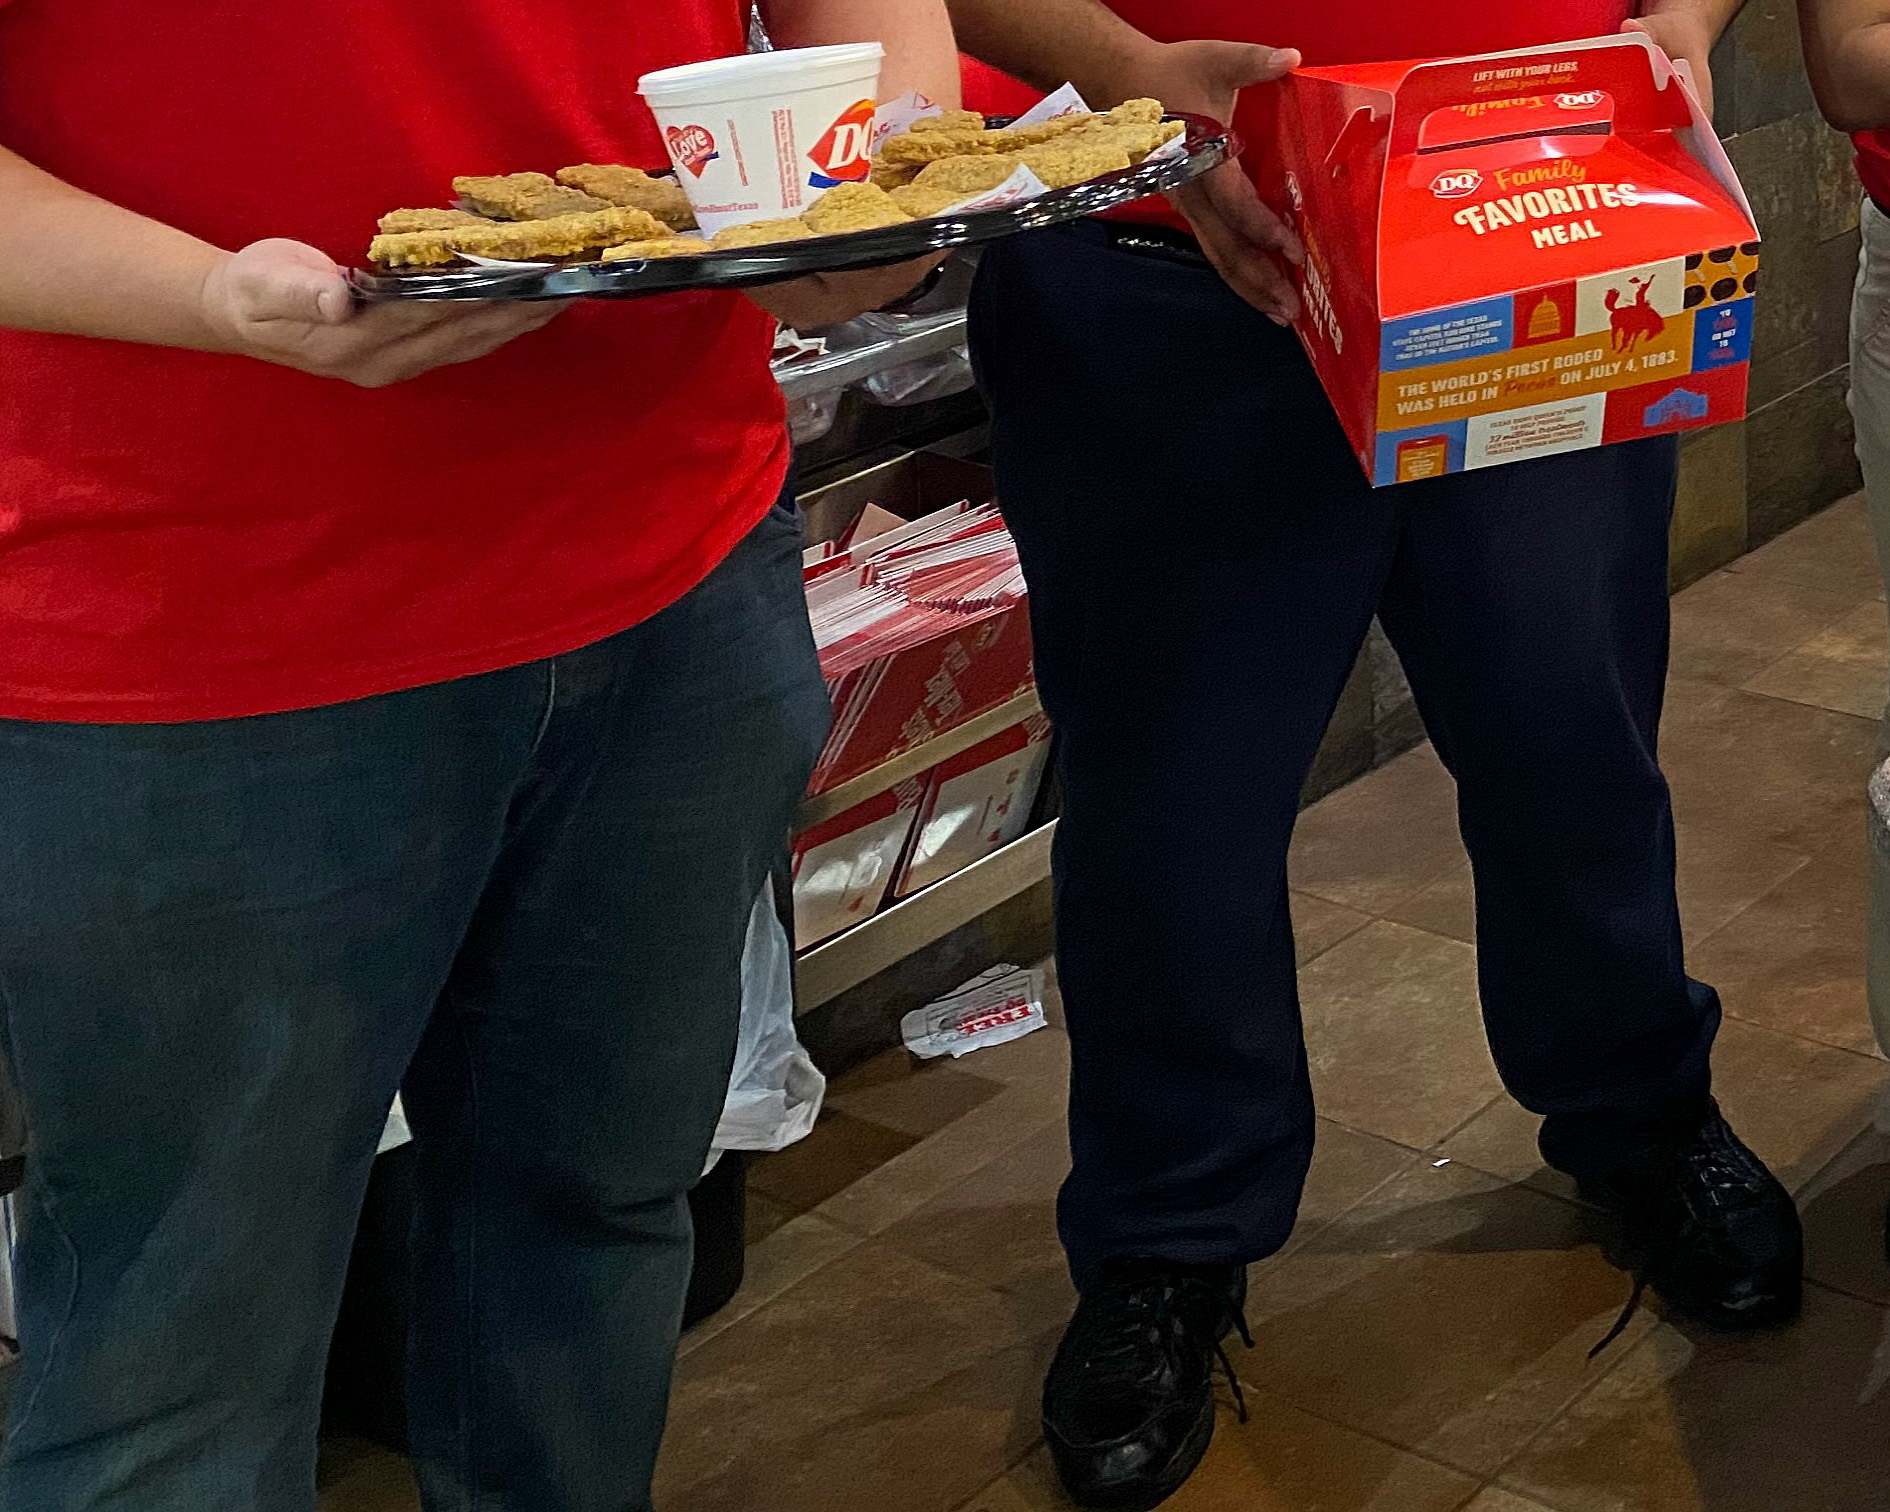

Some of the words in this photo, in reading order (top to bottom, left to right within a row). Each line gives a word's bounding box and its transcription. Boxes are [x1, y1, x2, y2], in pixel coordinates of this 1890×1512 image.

[1473, 70, 1494, 83] LIFT
[1494, 66, 1523, 80] WITH
[1524, 64, 1552, 76] YOUR
[1437, 173, 1477, 196] DQ
[1492, 159, 1588, 195] Family
[1453, 182, 1641, 237] FAVORITES
[1530, 219, 1602, 250] MEAL
[1396, 397, 1435, 416] WAS
[1438, 391, 1477, 411] HELD
[1481, 386, 1498, 401] IN
[1560, 369, 1583, 386] ON
[1585, 361, 1621, 383] JULY
[1624, 358, 1639, 375] 4,
[1397, 382, 1428, 398] THE
[1431, 368, 1503, 395] WORLD'S
[1506, 358, 1551, 382] FIRST
[1553, 348, 1603, 372] RODEO
